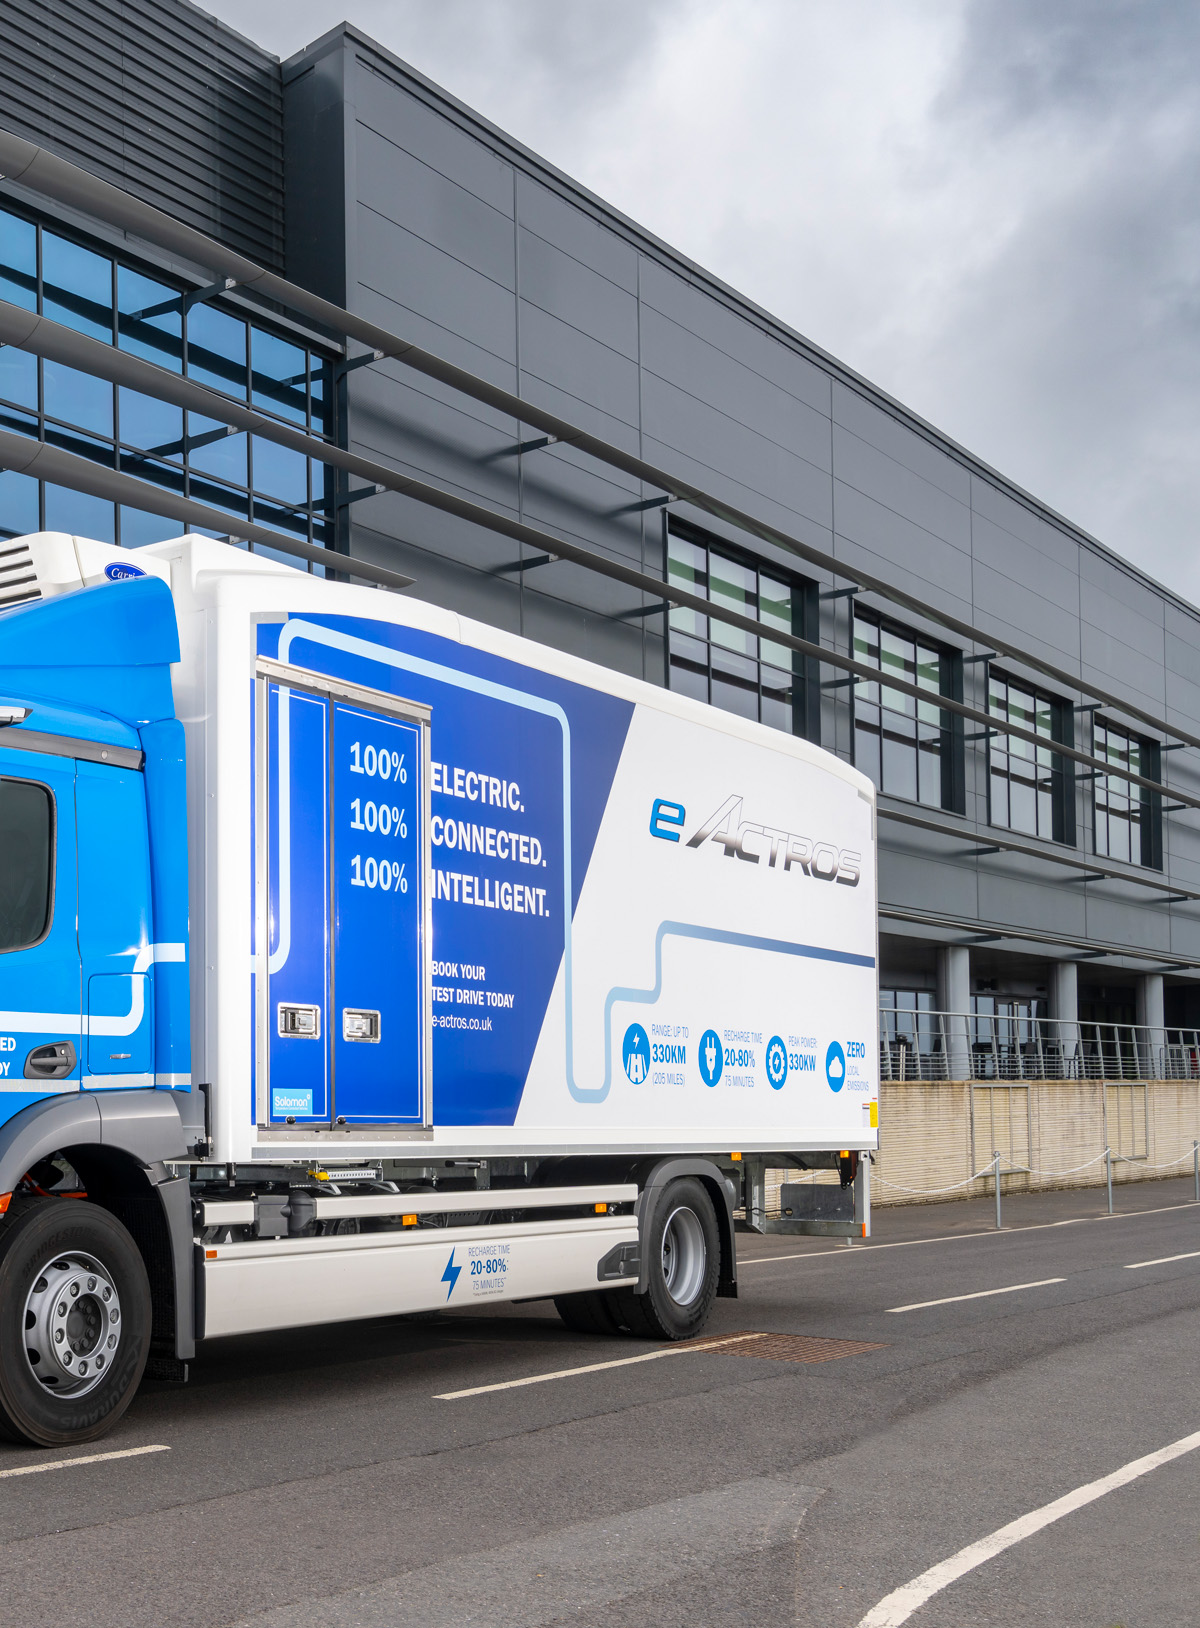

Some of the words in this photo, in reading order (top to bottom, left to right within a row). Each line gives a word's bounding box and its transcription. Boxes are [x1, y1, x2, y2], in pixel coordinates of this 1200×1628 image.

[350, 741, 408, 784] 100%
[430, 761, 525, 812] ELECTRIC.
[350, 798, 408, 839] 100%
[431, 815, 547, 867] CONNECTED.
[351, 854, 408, 894] 100%
[431, 869, 550, 917] INTELLIGENT.
[432, 960, 459, 978] BOOK
[460, 964, 486, 981] YOUR
[432, 986, 455, 1003] TEST
[456, 988, 484, 1006] DRIVE
[486, 991, 515, 1009] TODAY
[432, 1014, 493, 1031] e-actros.co.uk
[652, 1024, 672, 1037] RANGE:
[673, 1026, 681, 1038] UP
[682, 1026, 689, 1039] TO
[724, 1030, 750, 1042] RECHARGE
[788, 1035, 800, 1046] PEAK
[652, 1043, 686, 1064] 330KM
[724, 1048, 756, 1068] 20-80%
[846, 1041, 866, 1058] ZERO
[789, 1053, 817, 1071] 330KW
[847, 1065, 860, 1076] LOCAL
[652, 1072, 666, 1086] (205
[667, 1073, 686, 1087] MILES)
[725, 1074, 732, 1087] 75
[732, 1076, 755, 1088] MINUTES
[847, 1080, 870, 1092] EMISSIONS
[468, 1246, 497, 1256] RECHARGE
[498, 1245, 510, 1254] TIME
[473, 1280, 479, 1290] 75
